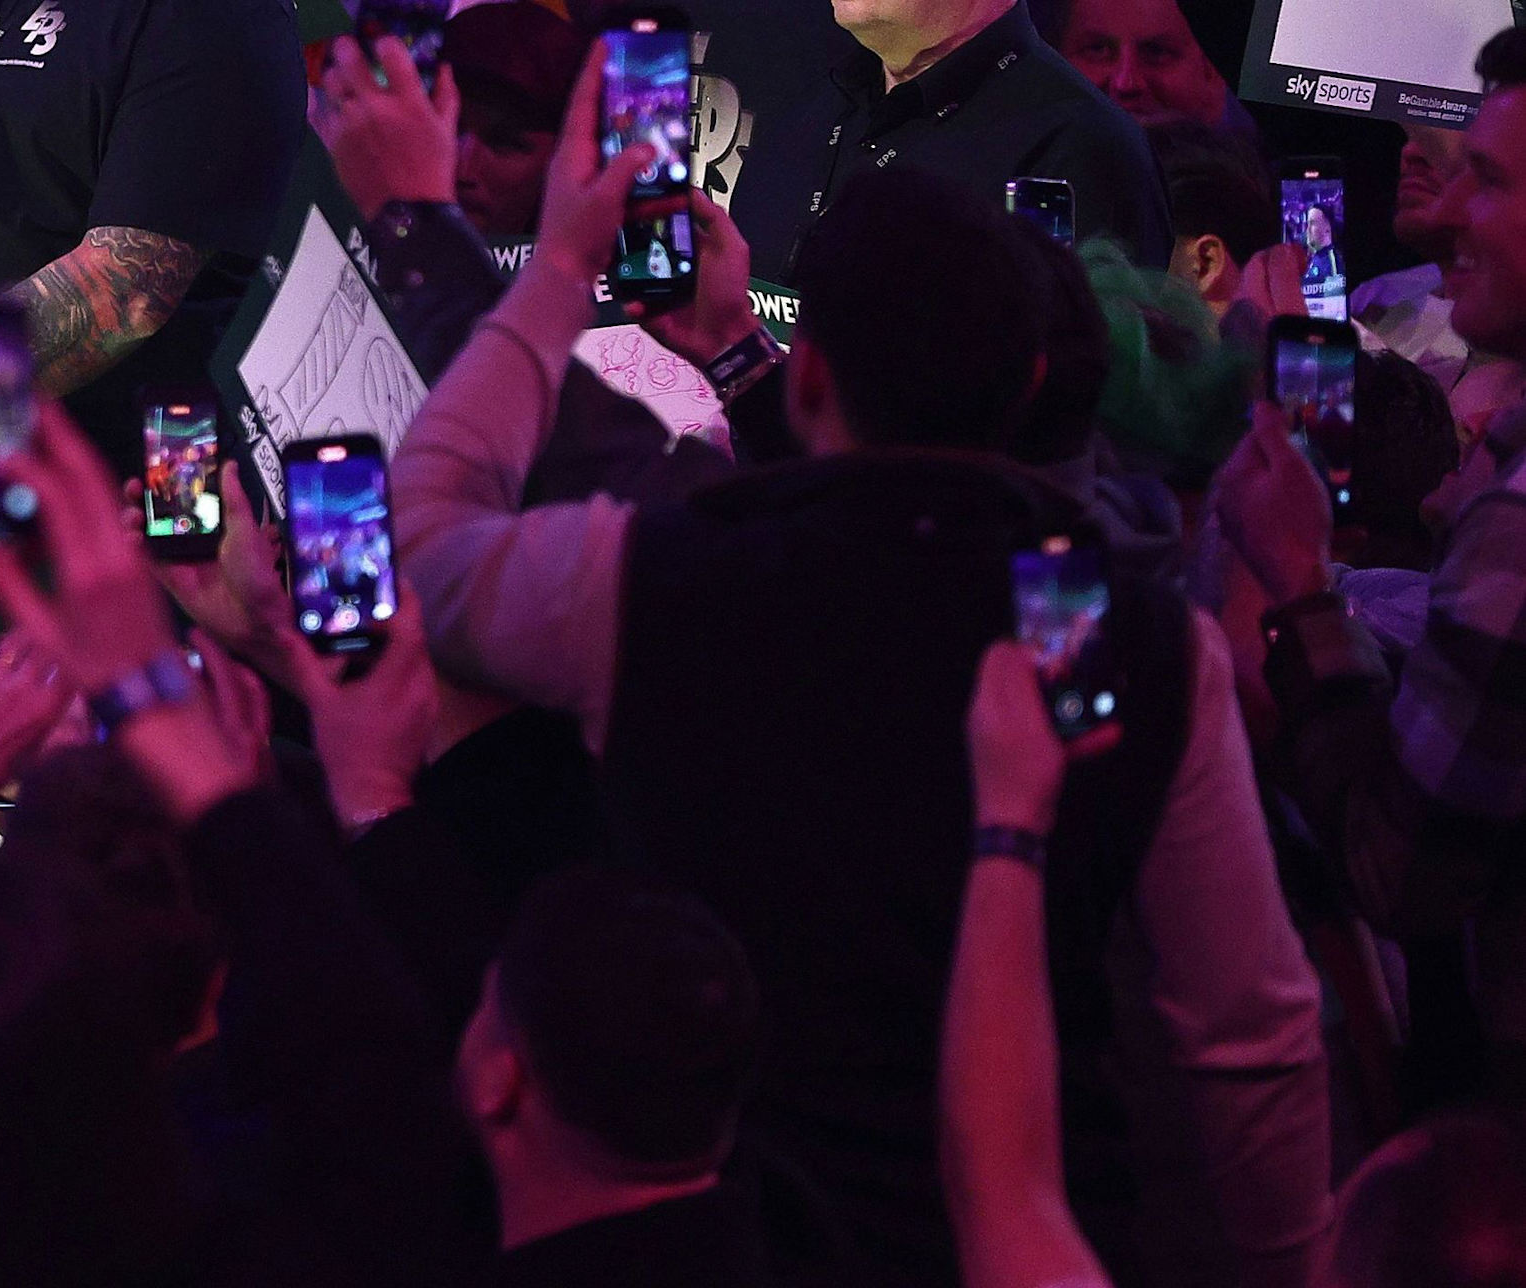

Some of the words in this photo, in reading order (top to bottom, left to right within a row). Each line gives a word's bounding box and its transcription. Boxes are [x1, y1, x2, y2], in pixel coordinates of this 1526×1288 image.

[998, 51, 1018, 71] EPS
[1286, 74, 1317, 101] sky
[1319, 82, 1372, 106] sports
[876, 147, 898, 169] EPS
